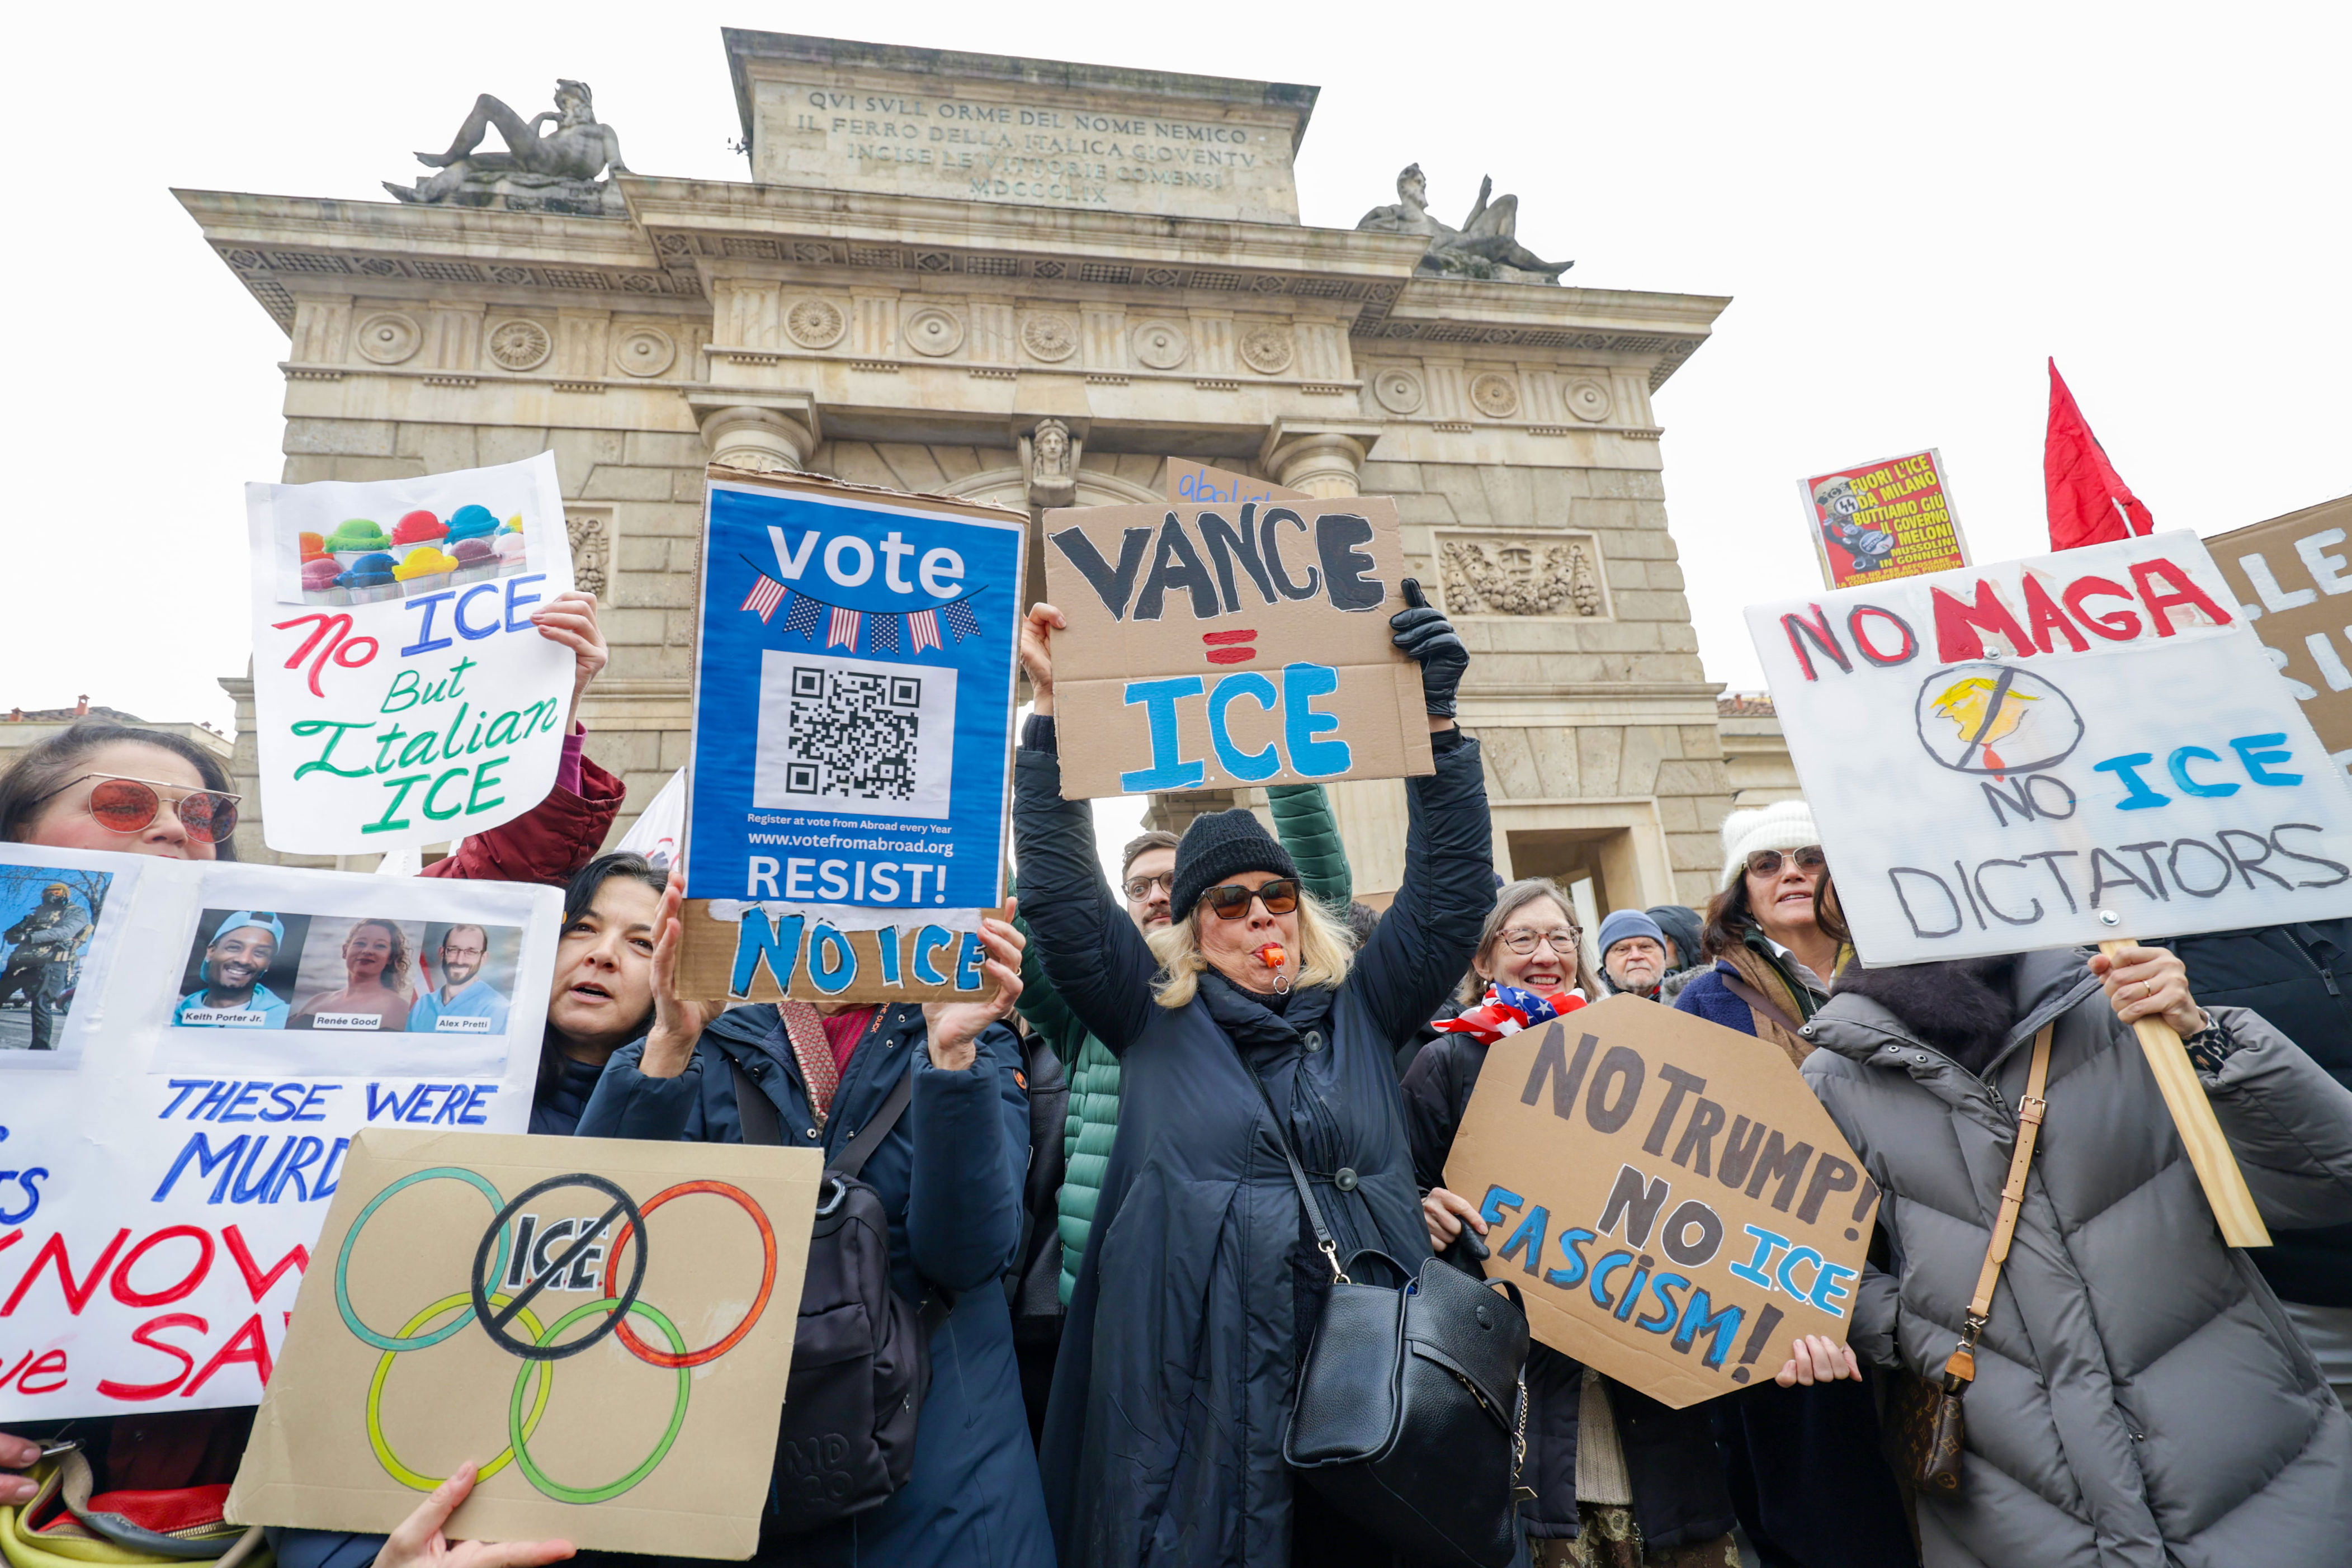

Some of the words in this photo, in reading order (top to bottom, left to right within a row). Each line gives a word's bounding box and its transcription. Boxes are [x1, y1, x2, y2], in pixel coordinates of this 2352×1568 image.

[798, 114, 822, 131] IL
[832, 117, 919, 139] FERRO
[929, 126, 1013, 148] DELLA
[1024, 134, 1123, 158] ITALICA
[1132, 144, 1256, 168] GIOVENTV
[809, 92, 856, 111] QVI
[866, 97, 927, 117] SVLL
[938, 104, 1012, 124] ORME
[1020, 111, 1065, 129] DEL
[1075, 116, 1146, 136] NOME
[1154, 122, 1247, 144] NEMICO
[847, 143, 932, 165] INCISE
[943, 150, 972, 168] LE
[983, 154, 1107, 180] VITTORIE
[1116, 166, 1222, 188] COMENSI
[969, 178, 1108, 204] MDCCCLIX
[1849, 467, 1893, 495] FUORI
[1893, 455, 1930, 479] L'ICE
[1856, 492, 1879, 510] DA
[1879, 470, 1939, 502] MILANO
[1852, 499, 1919, 526] BUTTIAMO
[1920, 492, 1945, 511] GIÙ
[1879, 522, 1892, 535] IL
[1893, 509, 1950, 532] GOVERNO
[1878, 558, 1893, 568] IN
[1896, 545, 1960, 564] GONNELLA
[1890, 537, 1957, 557] MUSSOLINI
[1897, 522, 1954, 546] MELONI
[767, 525, 965, 599] vote
[1048, 502, 1386, 623] VANCE
[1845, 573, 1865, 582] VOTA
[400, 573, 546, 658] ICE
[1780, 602, 1919, 681] NO
[1929, 557, 2234, 664] MAGA
[380, 656, 478, 714] But
[290, 696, 558, 781] Italian
[361, 756, 509, 834] ICE
[1981, 774, 2077, 827] NO
[2094, 733, 2304, 811] ICE
[747, 813, 792, 825] Register
[794, 817, 805, 825] at
[807, 818, 830, 827] vote
[833, 818, 857, 828] from
[859, 820, 898, 831] Abroad
[900, 824, 928, 834] every
[930, 825, 952, 834] Year
[748, 833, 954, 857] www.votefromabroad.org
[747, 856, 947, 904] RESIST!
[1888, 824, 2352, 939] DICTATORS
[728, 902, 858, 1000] NO
[876, 924, 986, 993] ICE
[185, 1012, 212, 1021] Keith
[216, 1014, 247, 1022] Porter
[249, 1014, 262, 1023] Jr.
[317, 1017, 348, 1025] Renée
[351, 1018, 378, 1026] Good
[159, 1080, 342, 1123] THESE
[366, 1082, 499, 1125] WERE
[1521, 1021, 1646, 1134] NO
[1642, 1062, 1880, 1241] TRUMP!
[1596, 1163, 1724, 1268] NO
